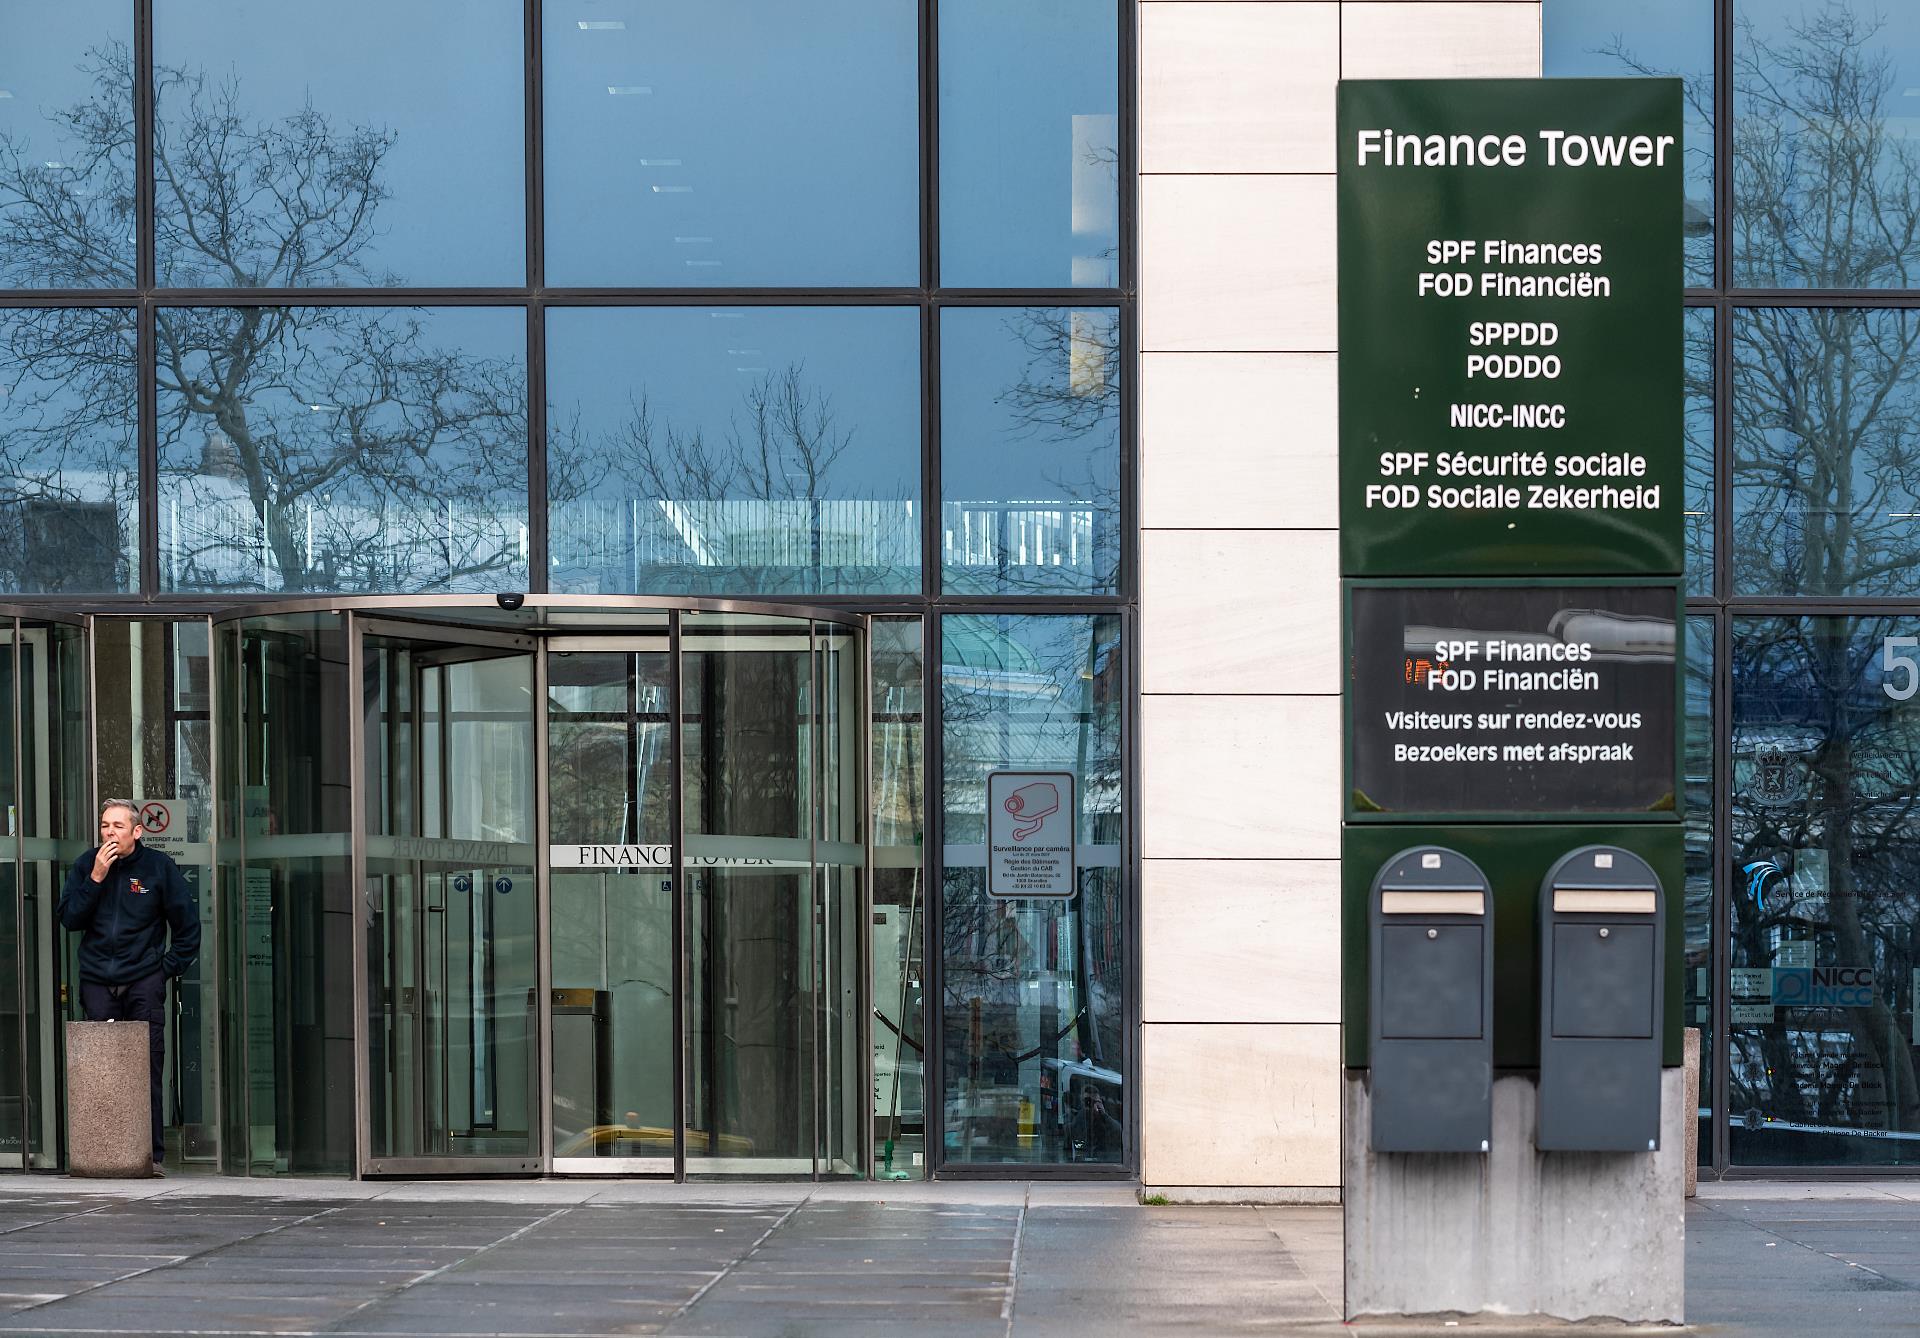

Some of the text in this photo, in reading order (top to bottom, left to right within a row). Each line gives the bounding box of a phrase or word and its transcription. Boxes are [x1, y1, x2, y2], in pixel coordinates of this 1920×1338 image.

[1357, 128, 1675, 167] Finance Tower
[1426, 239, 1602, 265] SPF Finances
[1418, 271, 1611, 298] FOD Financiën
[1469, 321, 1559, 346] SPPDD
[1467, 354, 1562, 379] PODDO
[1450, 403, 1566, 429] NICC-INCC
[1379, 450, 1647, 477] SPF Sécurité sociale
[1365, 484, 1660, 509] FOD Sociale Zekerheid
[1434, 640, 1592, 662] SPF Finances
[1427, 668, 1477, 692] FOD
[1483, 667, 1599, 691] Financiën
[1882, 636, 1919, 701] 5
[1384, 710, 1642, 730] Visiteurs sur rendez-vous
[1394, 742, 1634, 764] Bezoekers met afspraak
[1812, 967, 1872, 986] NICC
[1812, 987, 1873, 1006] INCC
